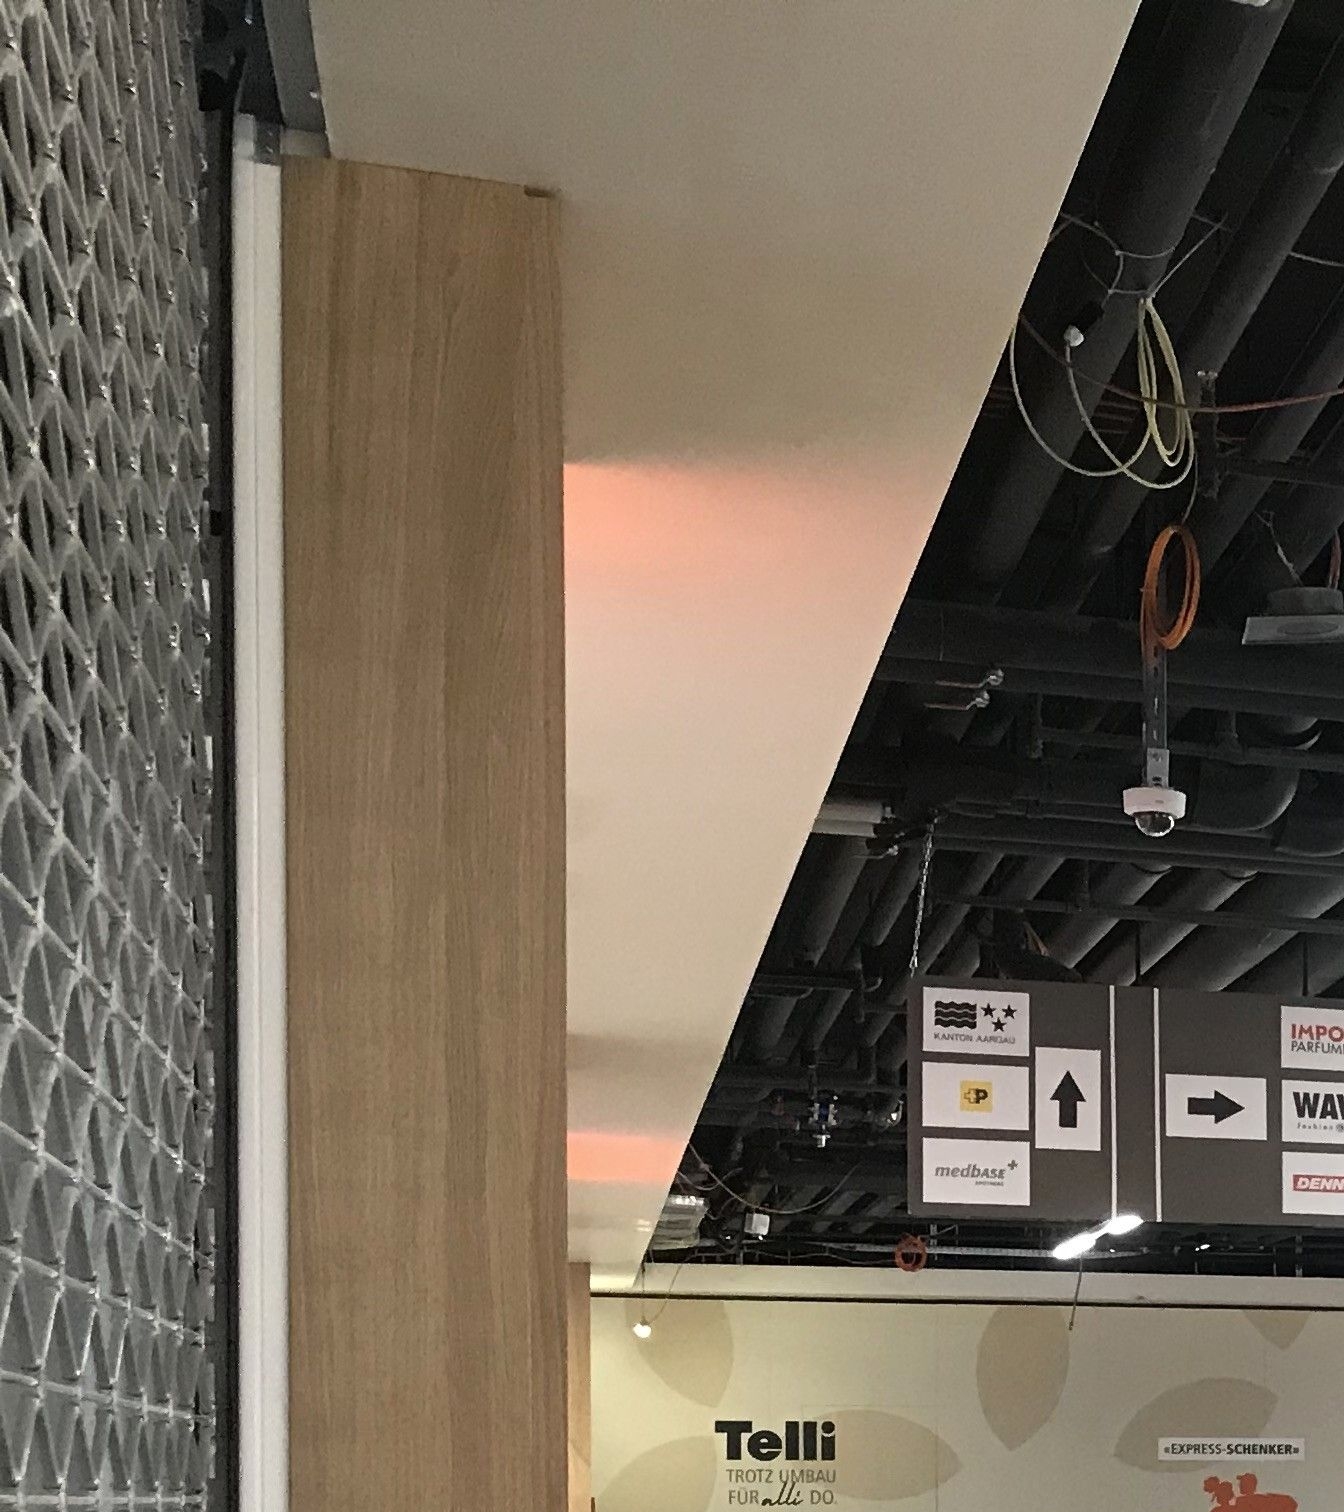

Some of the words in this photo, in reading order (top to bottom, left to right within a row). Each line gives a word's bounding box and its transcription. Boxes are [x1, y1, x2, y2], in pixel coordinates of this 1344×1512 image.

[933, 1032, 973, 1042] KANTON
[714, 1420, 836, 1462] Telli
[725, 1468, 774, 1483] TROTZ
[779, 1469, 837, 1483] UMBAU
[728, 1486, 759, 1505] FÜR
[761, 1480, 804, 1506] alli
